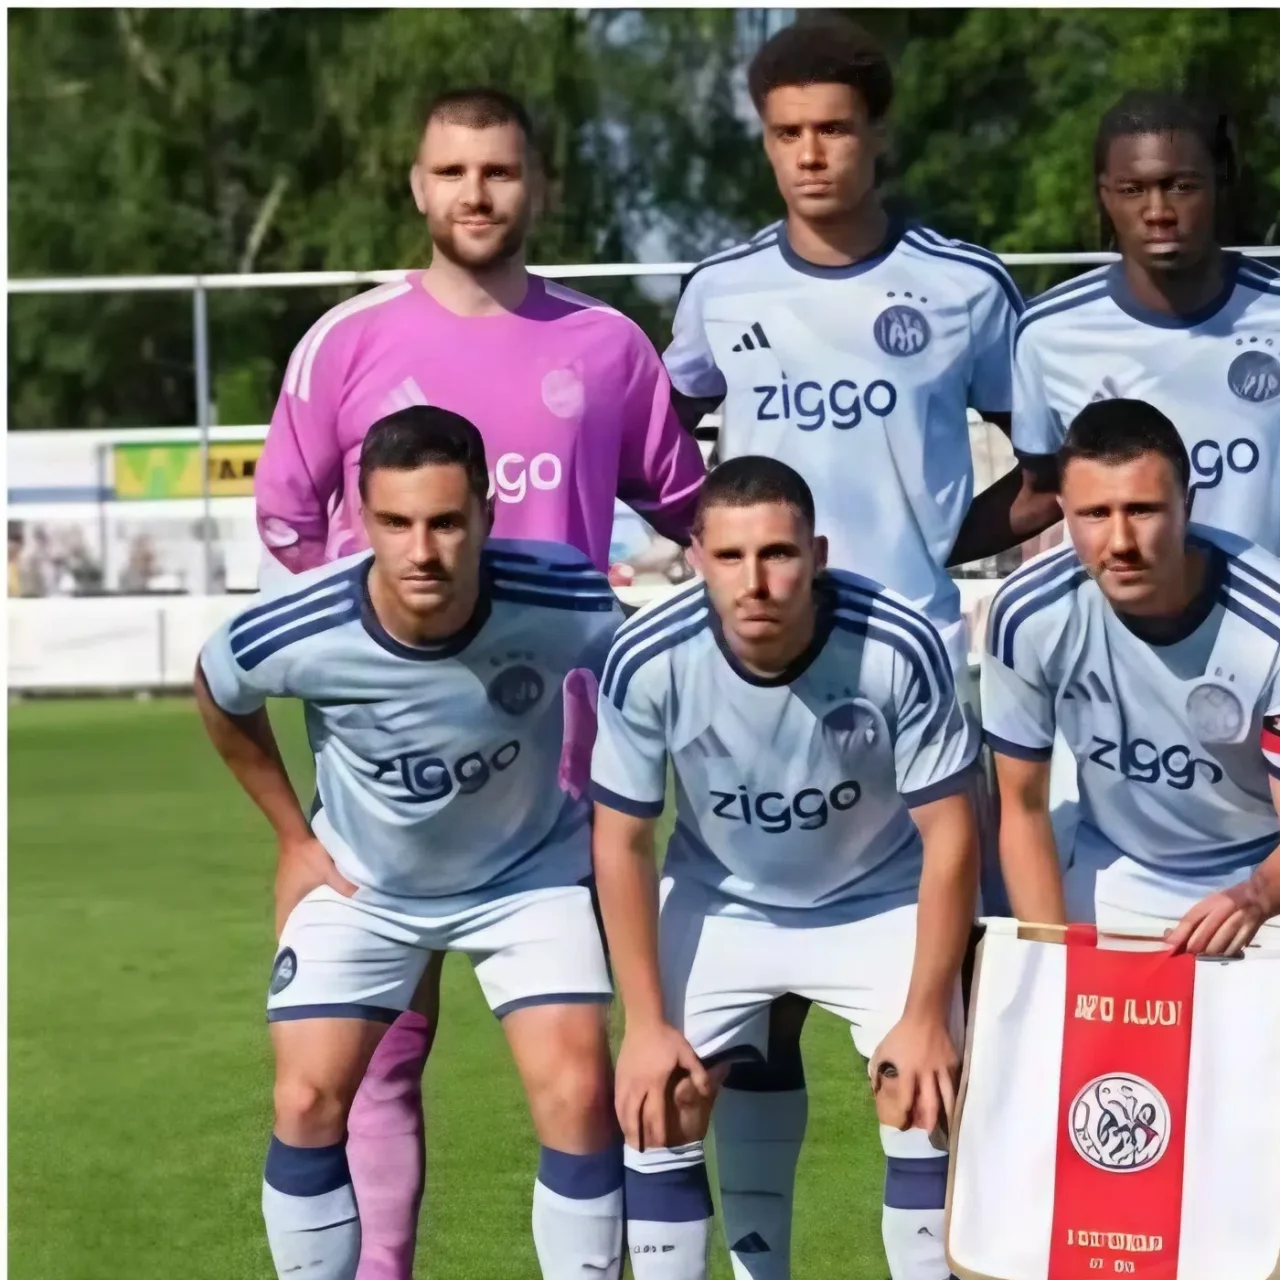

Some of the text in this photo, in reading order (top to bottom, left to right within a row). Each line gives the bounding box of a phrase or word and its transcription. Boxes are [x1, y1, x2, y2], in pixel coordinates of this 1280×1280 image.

[753, 370, 896, 431] ziggo
[487, 453, 561, 503] go
[709, 785, 861, 833] ziggo
